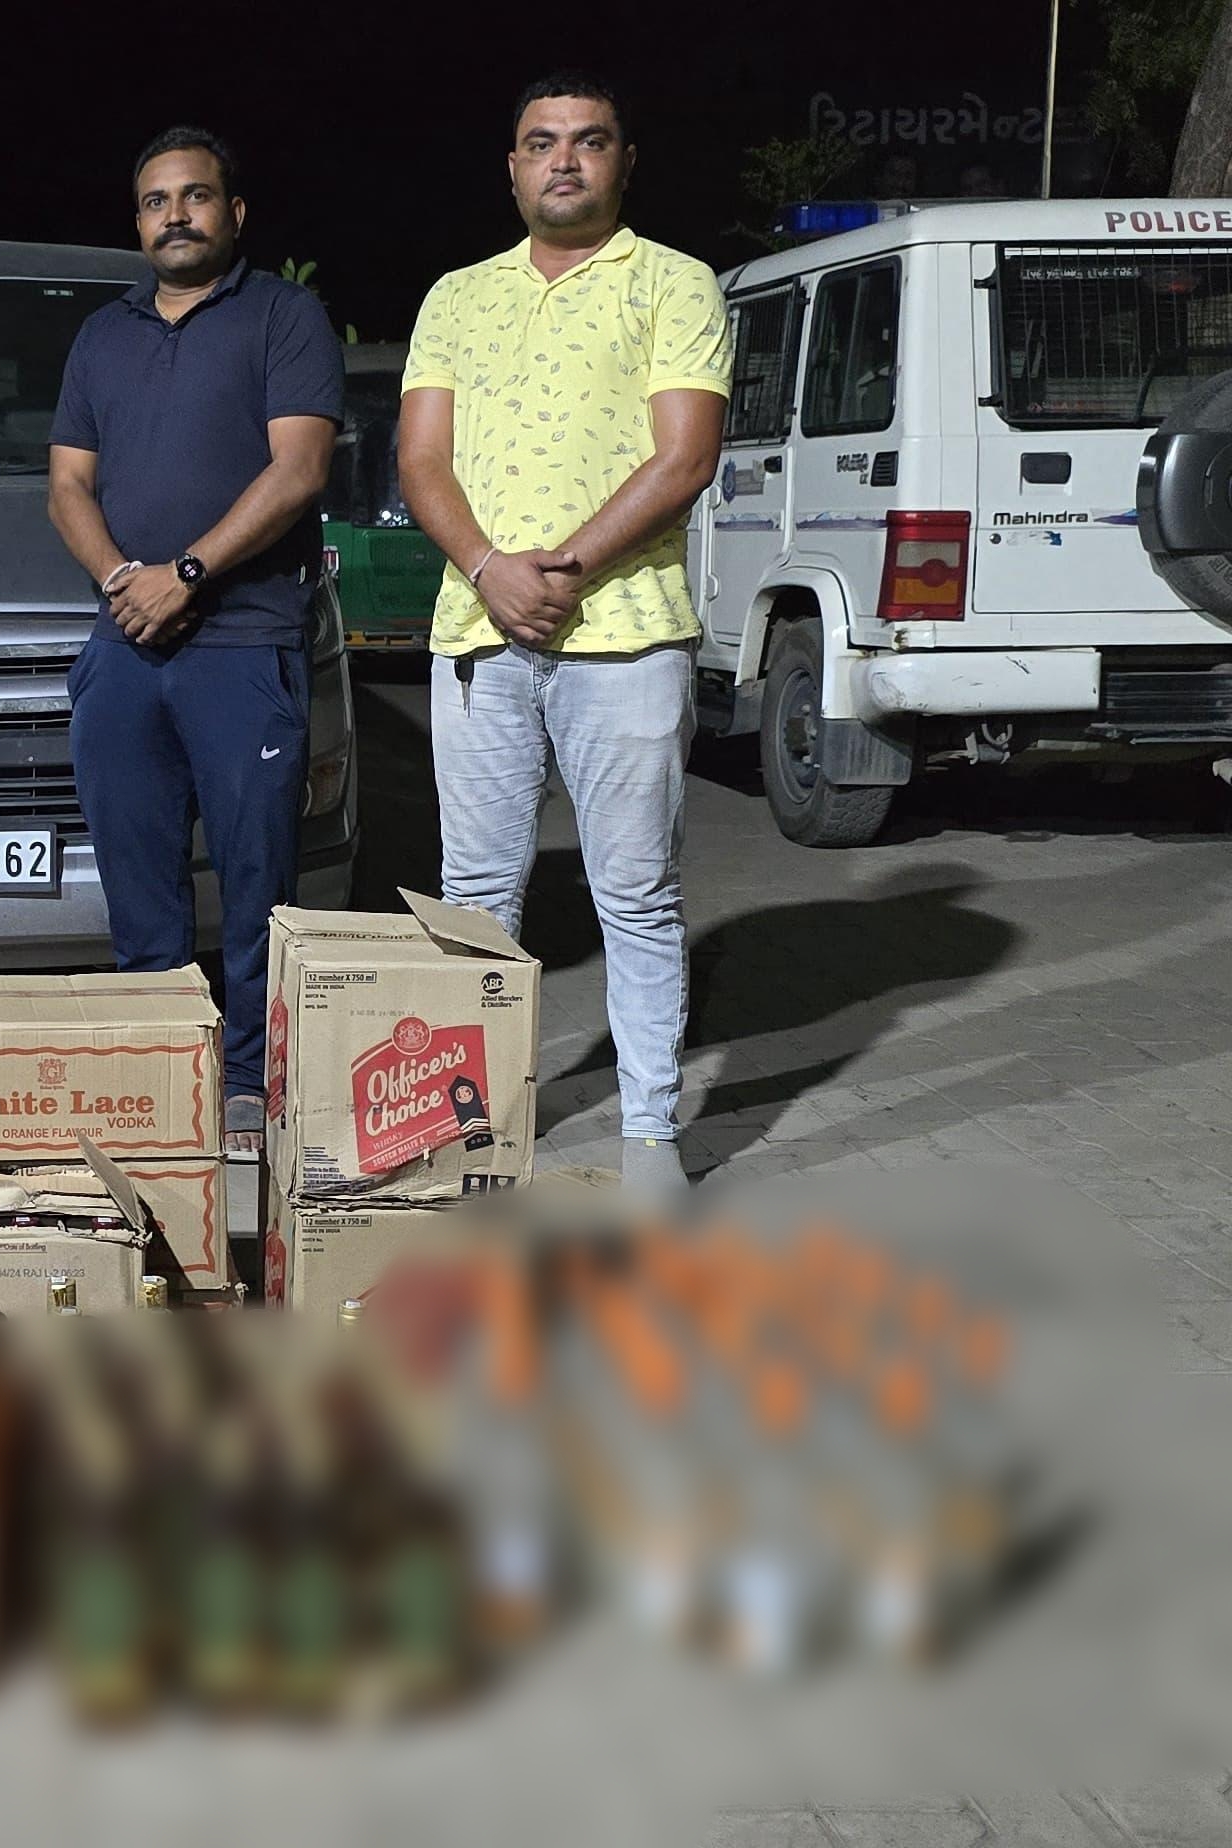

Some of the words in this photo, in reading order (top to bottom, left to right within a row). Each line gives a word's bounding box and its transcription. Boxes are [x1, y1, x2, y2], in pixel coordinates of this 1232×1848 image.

[1105, 211, 1232, 232] POLICE
[993, 510, 1089, 526] Mahindra
[319, 973, 344, 981] number
[367, 1041, 467, 1104] Officer's
[70, 1090, 155, 1114] Lace
[365, 1089, 444, 1137] Choice
[107, 1116, 156, 1129] VODKA
[2, 1128, 49, 1139] ORANGE
[51, 1127, 103, 1138] FLAVOUR
[23, 1268, 42, 1278] RAJ
